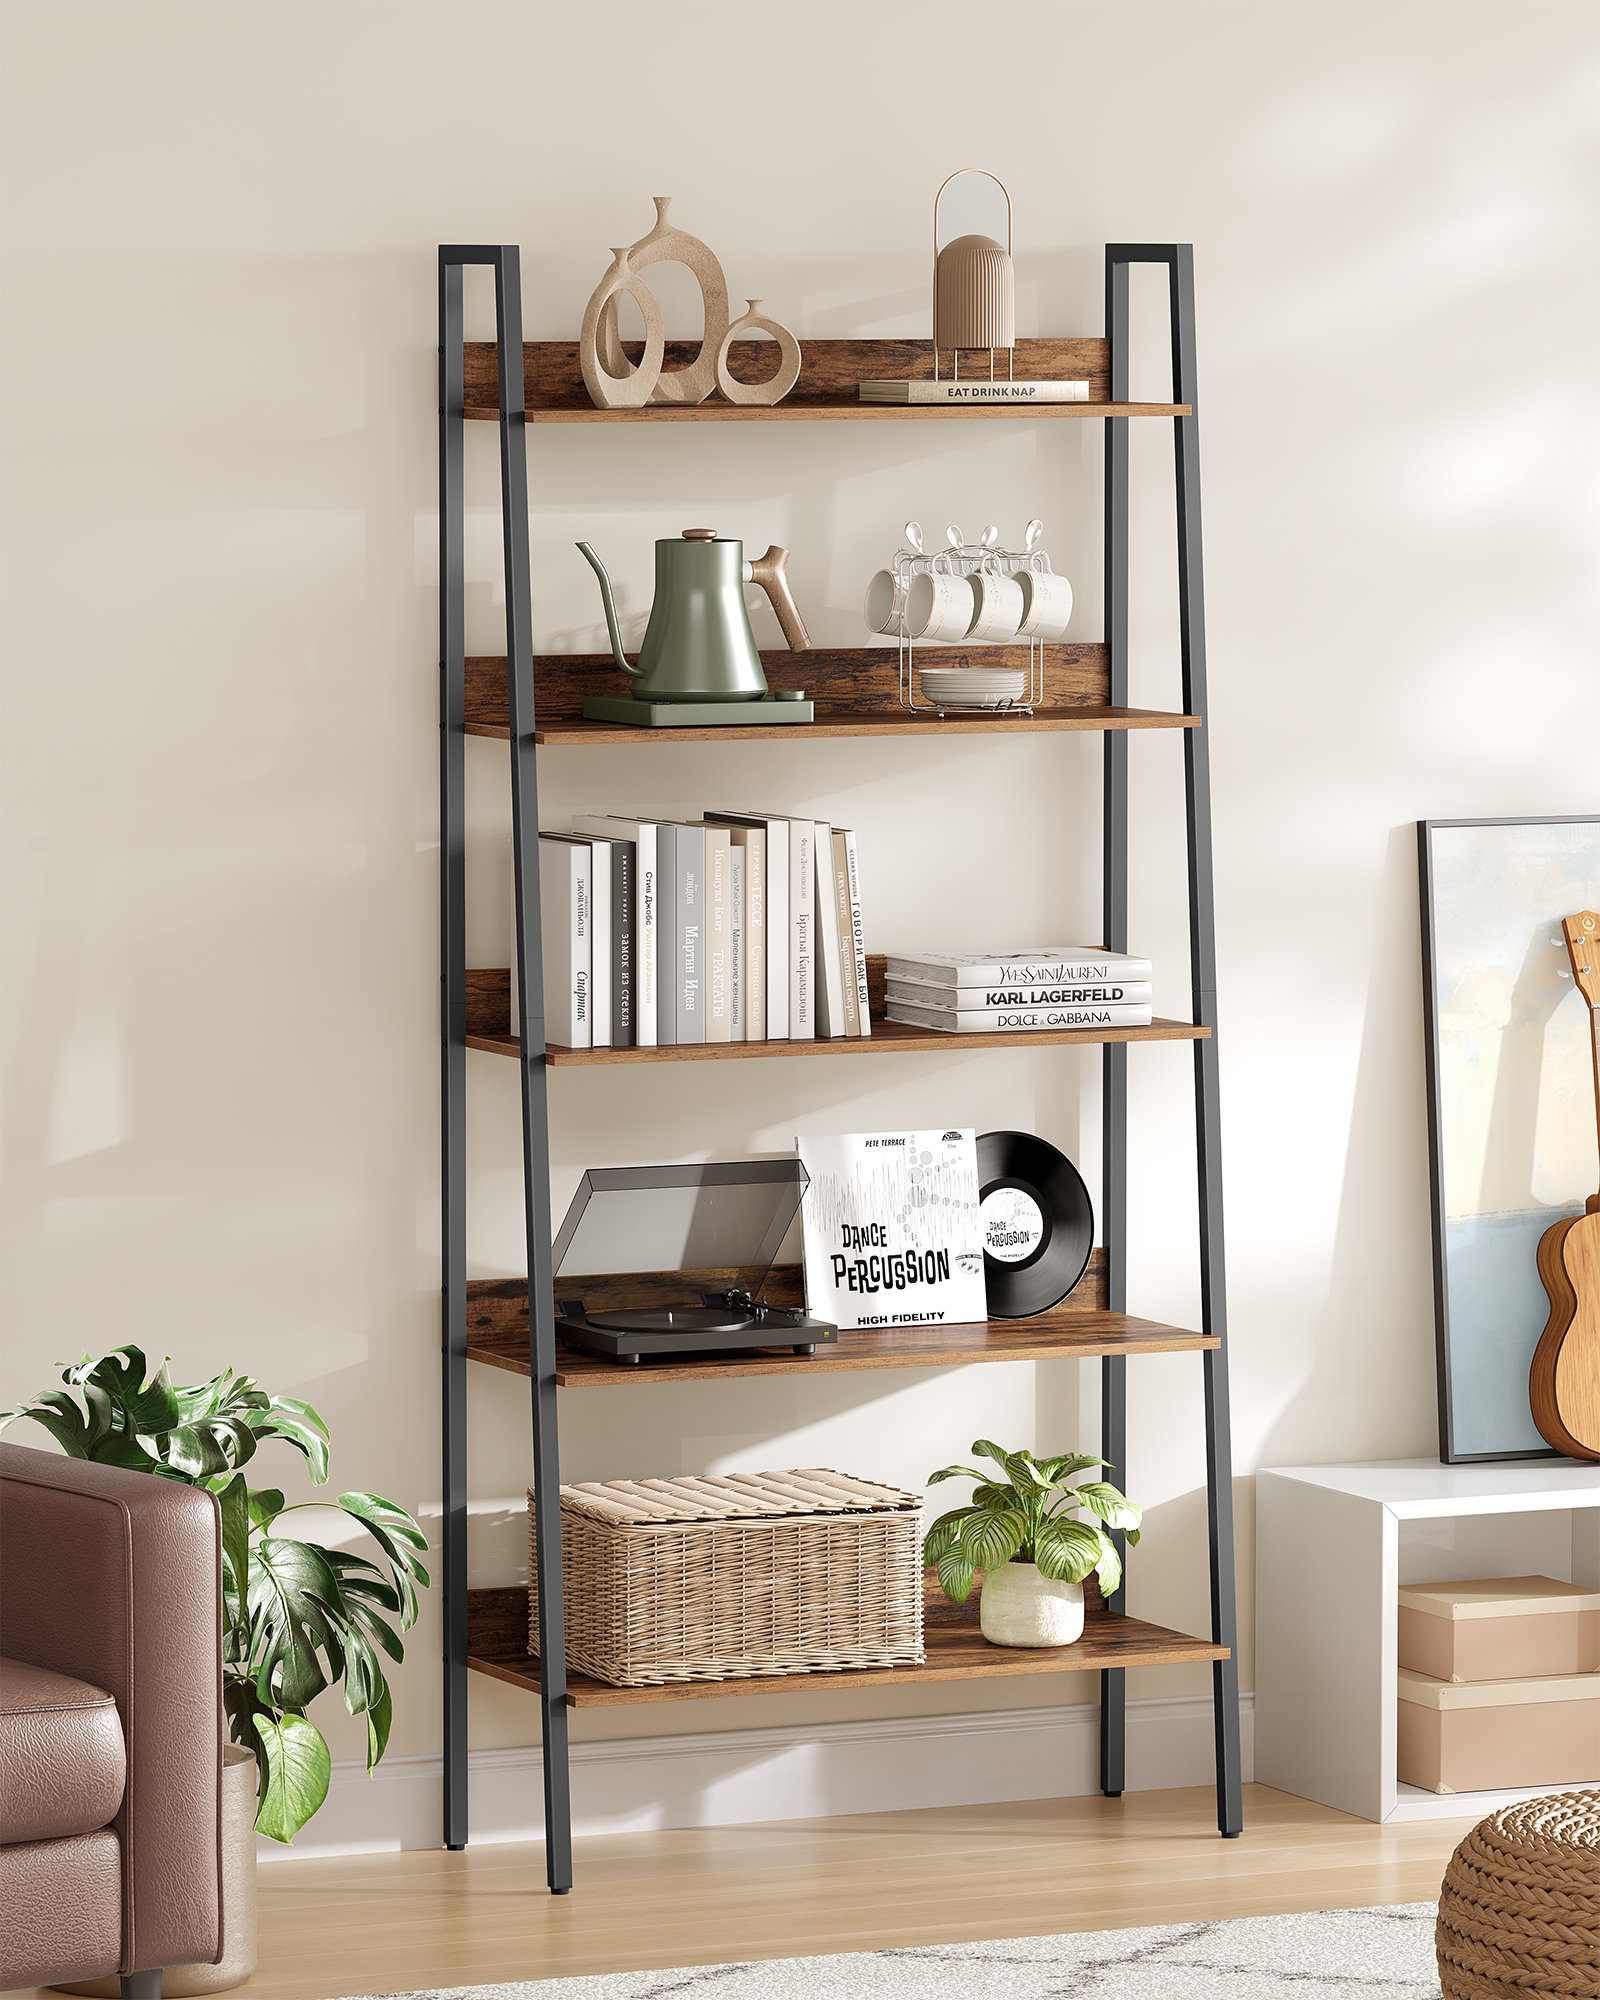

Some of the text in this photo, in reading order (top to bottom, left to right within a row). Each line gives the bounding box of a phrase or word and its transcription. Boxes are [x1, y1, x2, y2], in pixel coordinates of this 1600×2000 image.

[947, 387, 1036, 397] EAT DRINK NAP
[577, 877, 585, 937] ДЖОВАНЬОЛИ
[645, 871, 653, 926] Стив Джобс
[713, 849, 724, 932] Иммануил Кант
[752, 886, 763, 927] ГЕССЕ
[683, 925, 699, 1010] Мартин Иден
[732, 928, 741, 1025] Маленькие женщины
[796, 913, 810, 1023] Братья Карамазовы
[852, 902, 869, 1005] ГОВОРИ КАК БОГ
[574, 971, 588, 1022] Спартак
[713, 950, 724, 1017] ТРАКТАТЫ
[986, 988, 1124, 1006] KARL LAGERFELD
[998, 1014, 1038, 1027] DOLCE
[1047, 1011, 1112, 1025] GABBANA
[865, 1138, 906, 1148] PETE TERRACE
[842, 1222, 887, 1253] DANCE
[830, 1248, 951, 1294] PERCUSSION
[857, 1311, 945, 1326] HIGH FIDELITY
